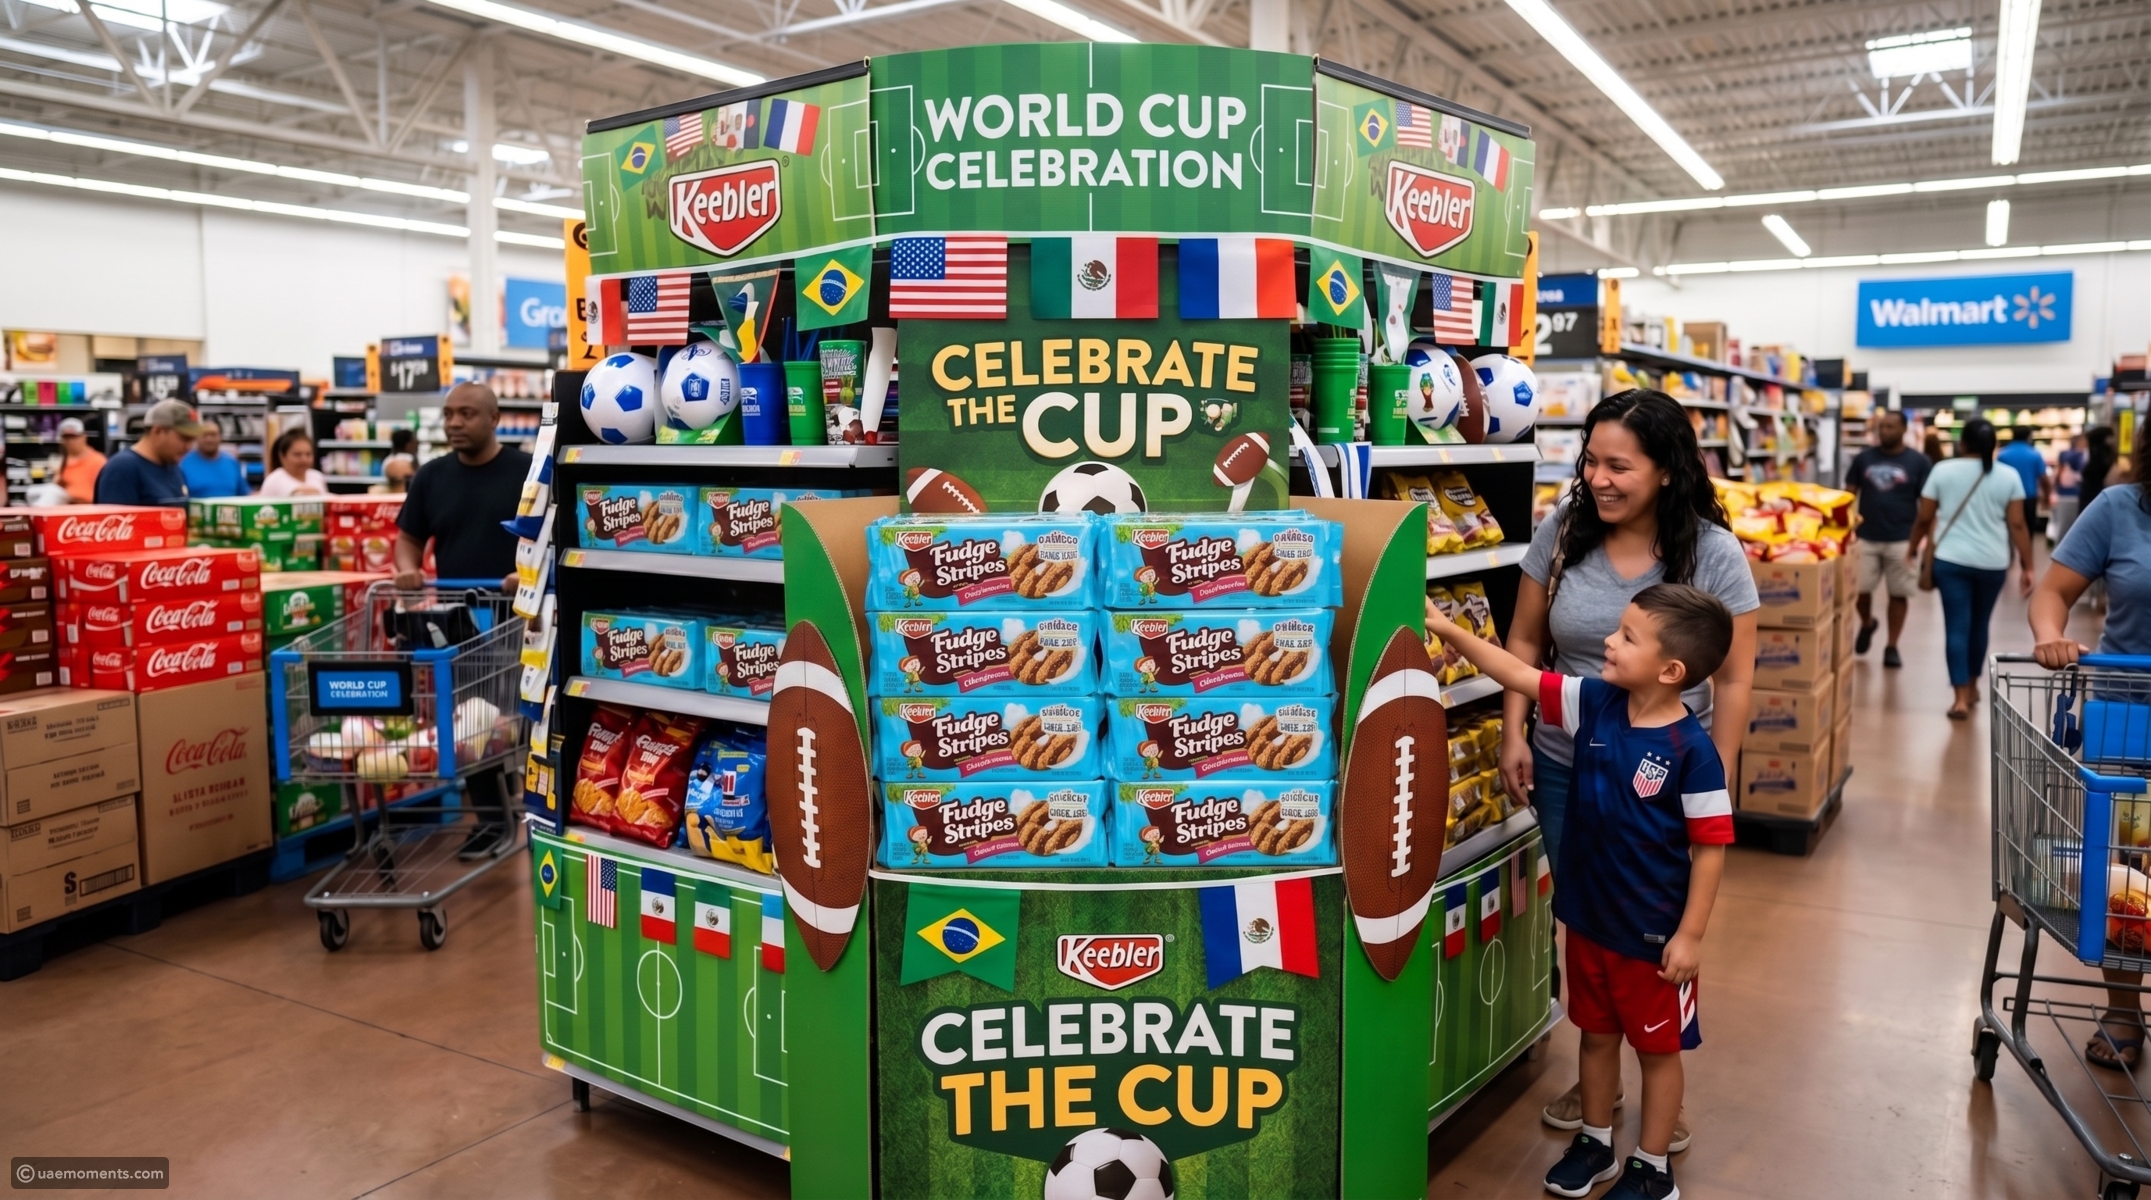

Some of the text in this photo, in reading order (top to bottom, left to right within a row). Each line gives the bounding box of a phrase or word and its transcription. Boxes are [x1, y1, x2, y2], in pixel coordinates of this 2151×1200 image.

[924, 93, 1247, 142] WORLD CUP
[926, 148, 1242, 190] CELEBRATION
[676, 180, 775, 238] Keebler
[1388, 169, 1471, 232] Keebler
[1870, 294, 2008, 327] Walmart
[932, 338, 1258, 392] CELEBRATE
[947, 391, 1193, 458] THE CUP
[599, 497, 635, 517] Fudge
[727, 501, 769, 519] Fudge
[603, 511, 641, 531] Stripes
[731, 516, 773, 536] Stripes
[930, 541, 996, 567] Fudge
[1165, 539, 1231, 564] Fudge
[936, 559, 1006, 586] Stripes
[1171, 556, 1241, 583] Stripes
[607, 629, 643, 646] Fudge
[1132, 618, 1168, 633] Keebler
[610, 644, 647, 662] Stripes
[734, 642, 775, 661] Fudge
[930, 629, 997, 653] Fudge
[1166, 629, 1233, 653] Fudge
[737, 659, 780, 679] Stripes
[937, 646, 1006, 673] Stripes
[1172, 646, 1241, 674] Stripes
[329, 680, 387, 690] WORLD CUP
[331, 690, 388, 698] CELEBRATION
[932, 714, 998, 737] Fudge
[1169, 714, 1235, 737] Fudge
[938, 731, 1009, 757] Stripes
[1174, 731, 1244, 757] Stripes
[938, 799, 1006, 823] Fudge
[1171, 799, 1238, 823] Fudge
[944, 817, 1014, 844] Stripes
[1177, 817, 1246, 844] Stripes
[64, 871, 77, 894] S
[1062, 937, 1162, 976] Keebler
[921, 1003, 1295, 1065] CELEBRATE
[941, 1064, 1283, 1135] THE CUP
